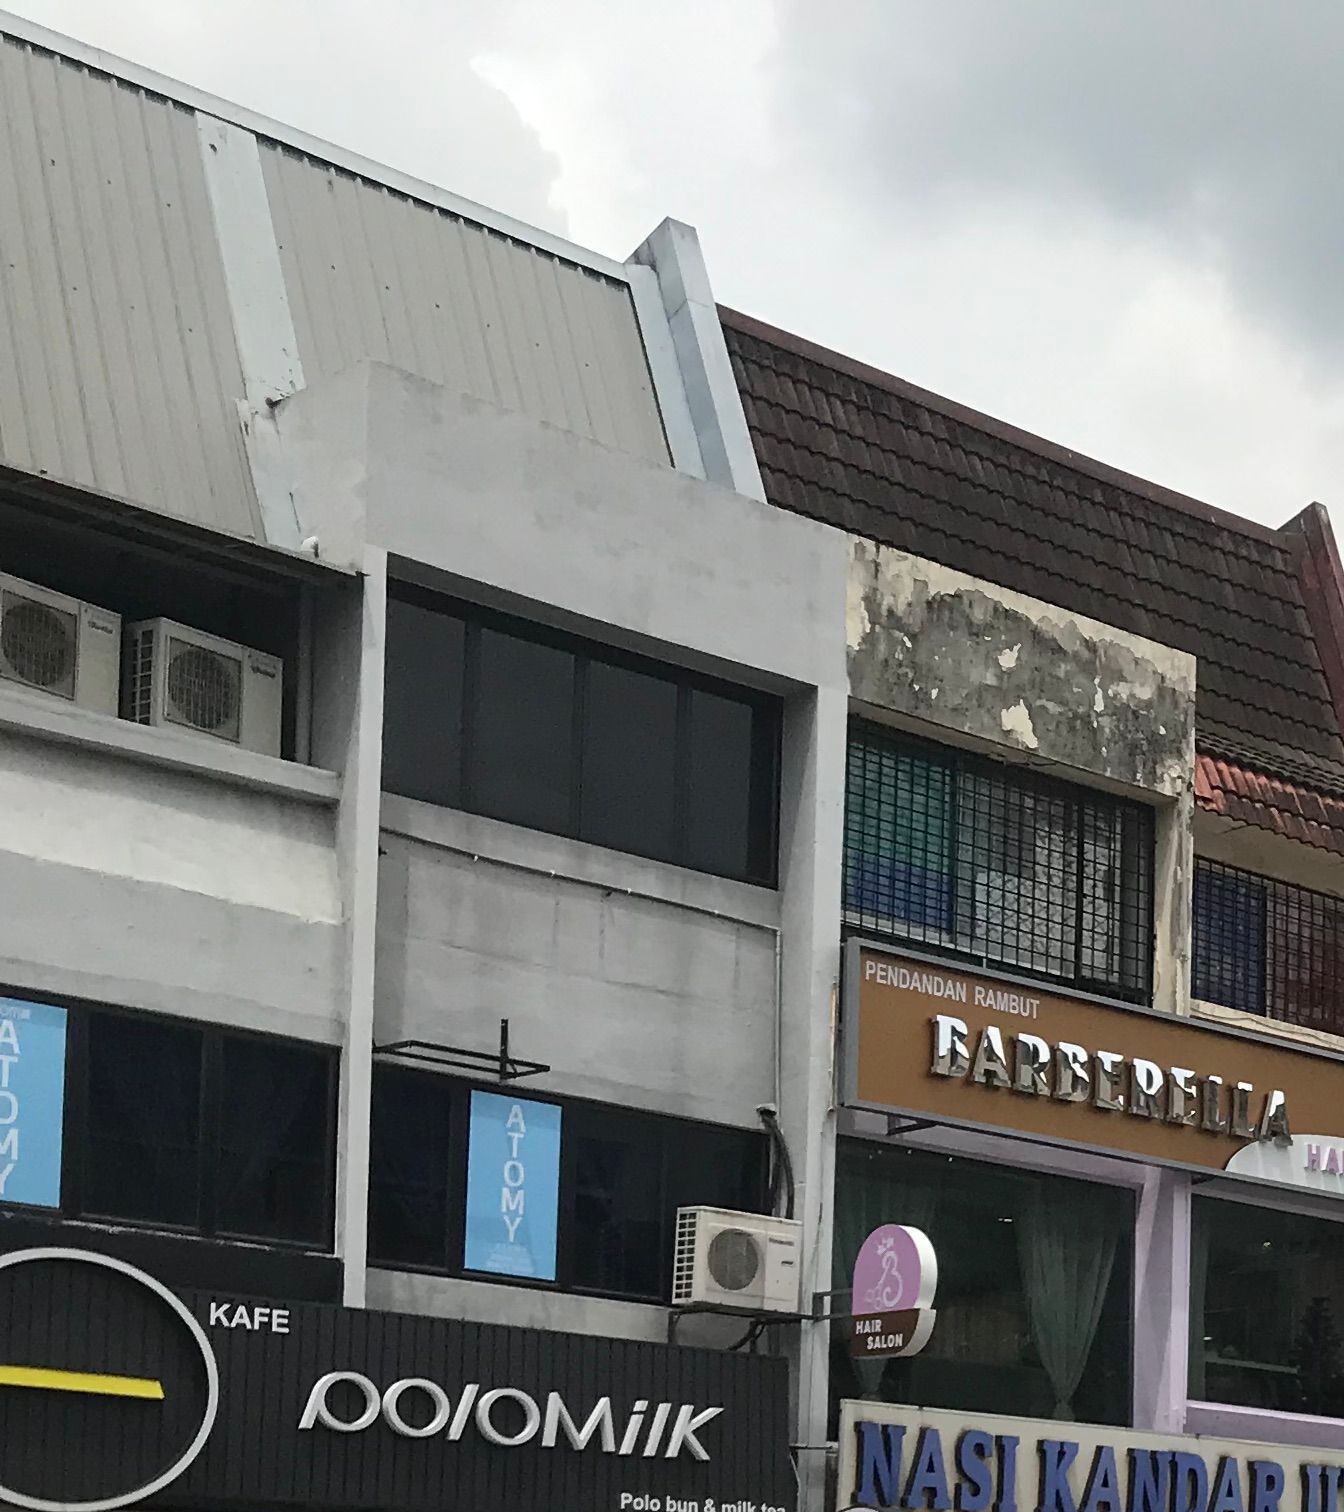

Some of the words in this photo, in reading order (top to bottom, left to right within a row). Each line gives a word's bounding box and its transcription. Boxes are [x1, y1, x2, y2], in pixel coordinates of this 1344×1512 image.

[865, 960, 967, 1003] PENDANDAN
[974, 987, 1040, 1019] RAMBUT
[930, 1014, 1293, 1146] BARBERELLA
[501, 1104, 526, 1243] ATOMY
[209, 1303, 290, 1334] KAFE
[856, 1319, 882, 1334] HAIR
[867, 1333, 903, 1350] SALON
[620, 1492, 660, 1511] Polo
